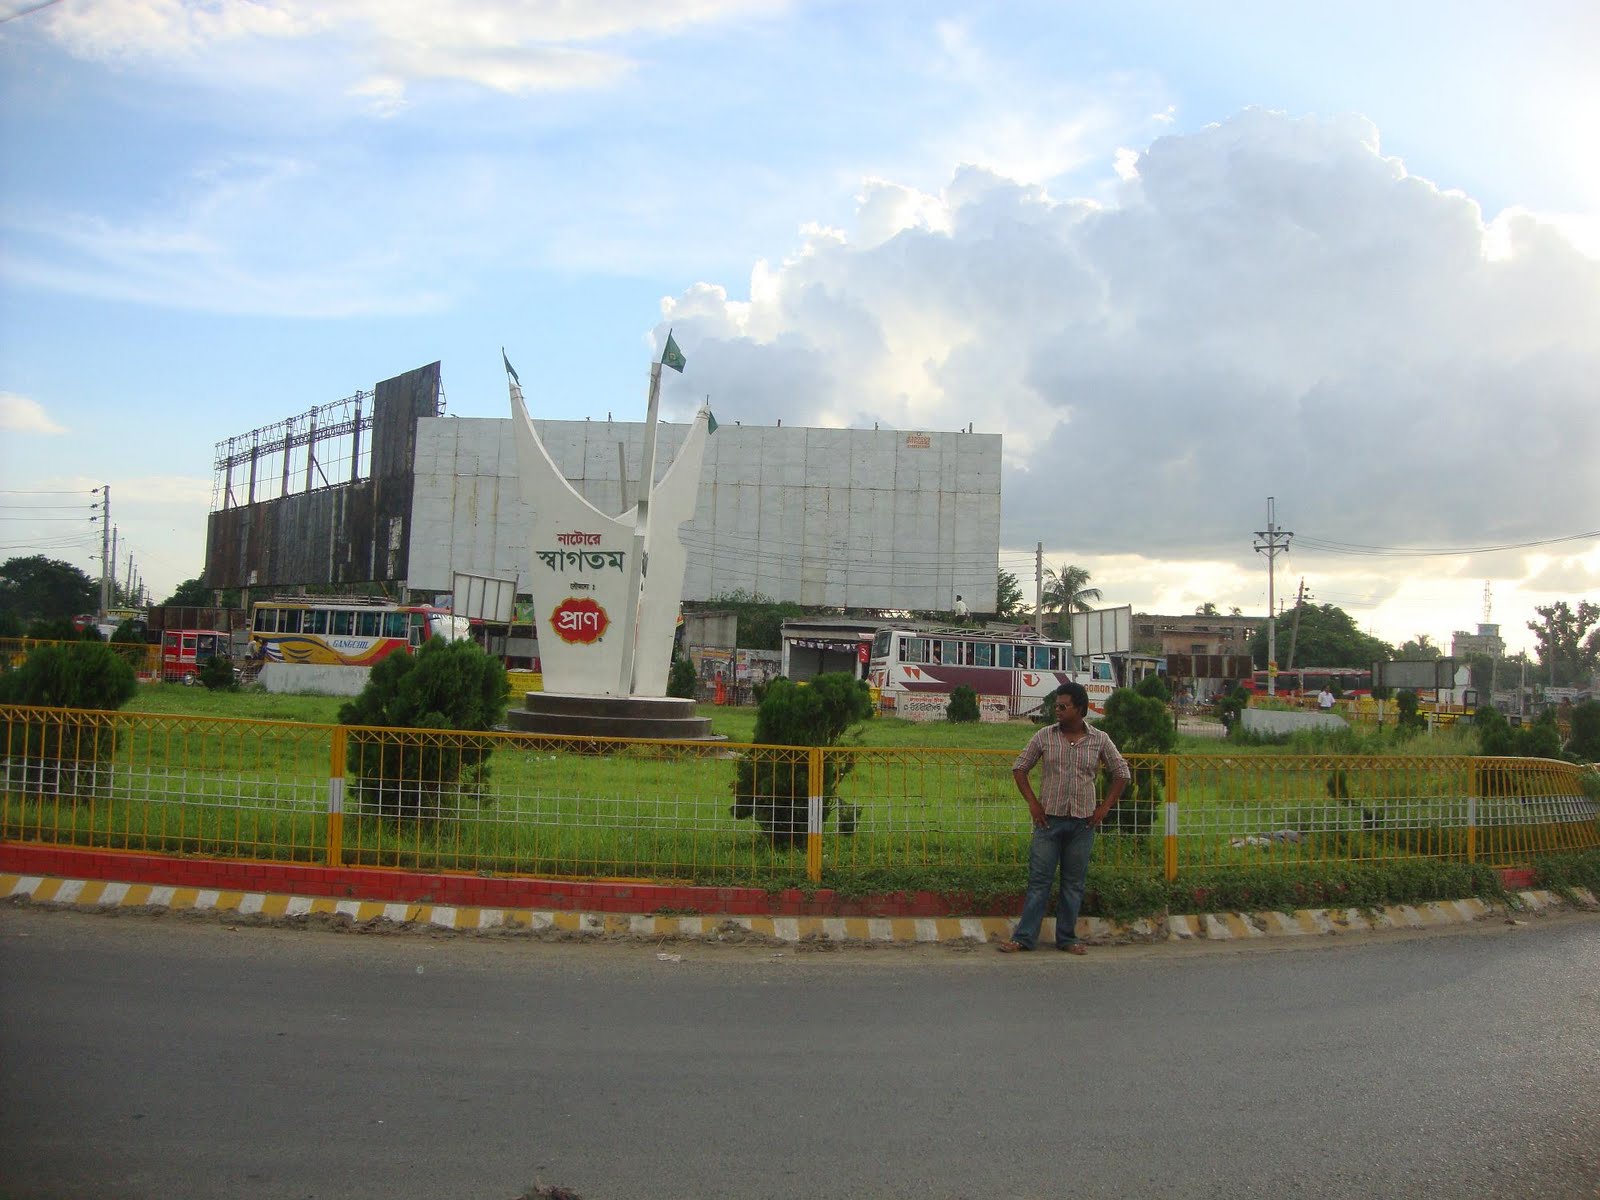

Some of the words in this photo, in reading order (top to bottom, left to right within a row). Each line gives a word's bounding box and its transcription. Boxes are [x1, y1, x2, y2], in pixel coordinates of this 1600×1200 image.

[557, 530, 602, 546] নাটোরে
[536, 549, 626, 573] স্বাগতম
[558, 610, 599, 631] প্রাণ
